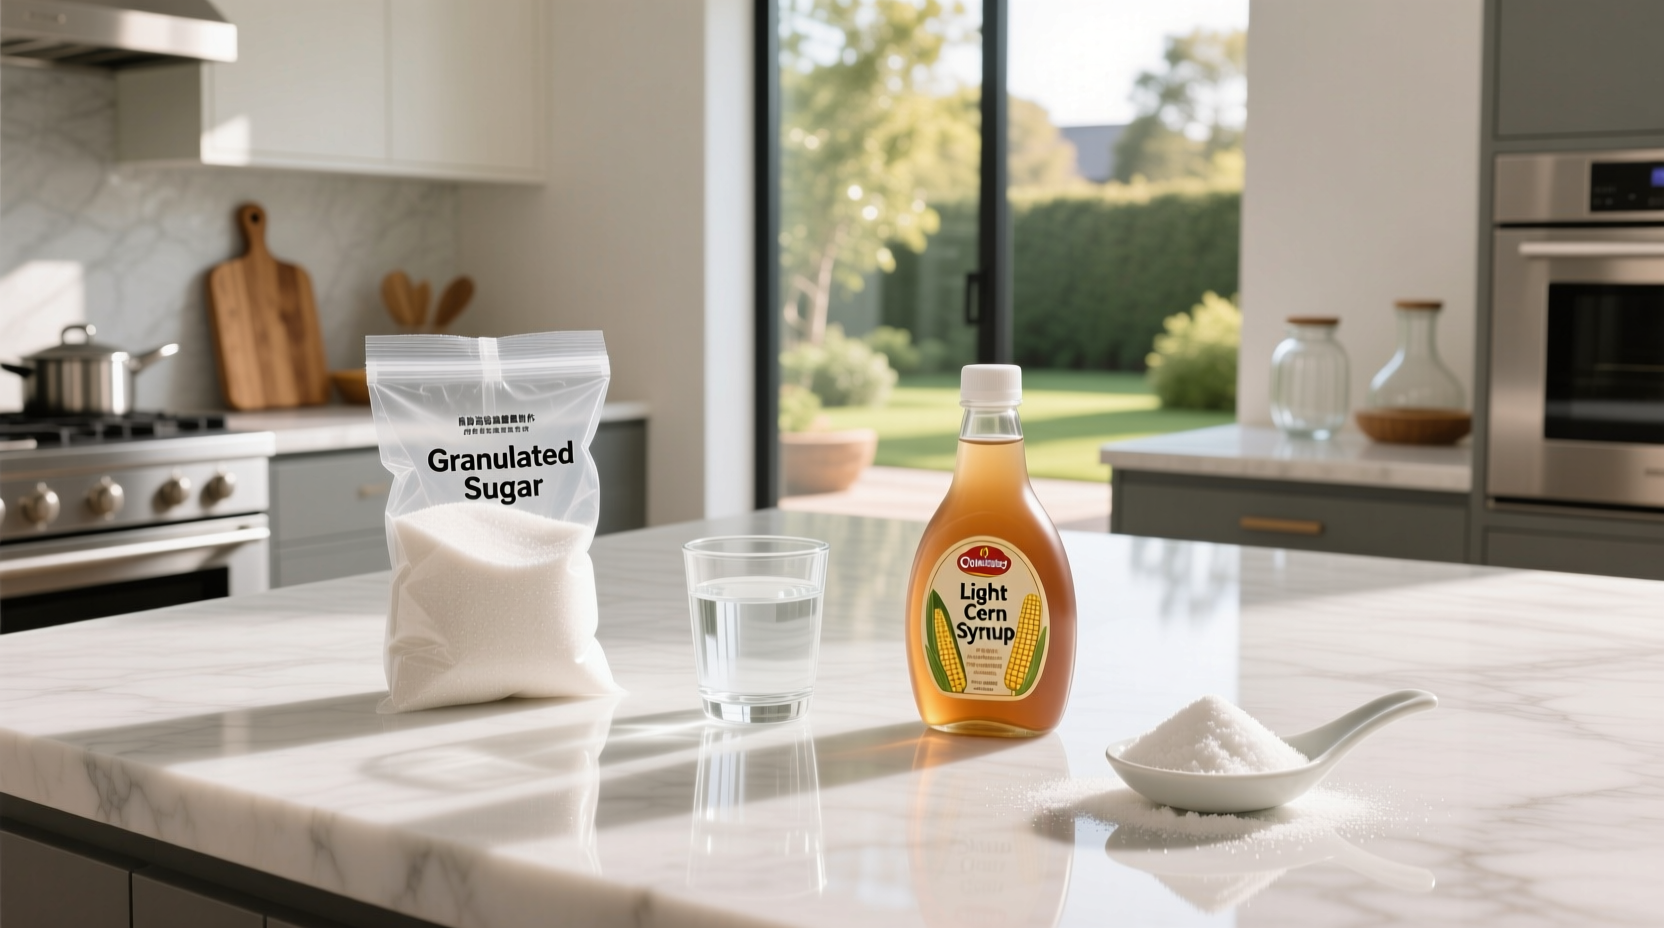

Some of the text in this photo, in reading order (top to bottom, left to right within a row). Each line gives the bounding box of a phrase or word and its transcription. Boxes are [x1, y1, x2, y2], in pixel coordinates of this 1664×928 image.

[428, 440, 574, 472] Granulated
[464, 475, 544, 505] Sugar
[960, 582, 1008, 605] Light
[964, 603, 1007, 622] Cern
